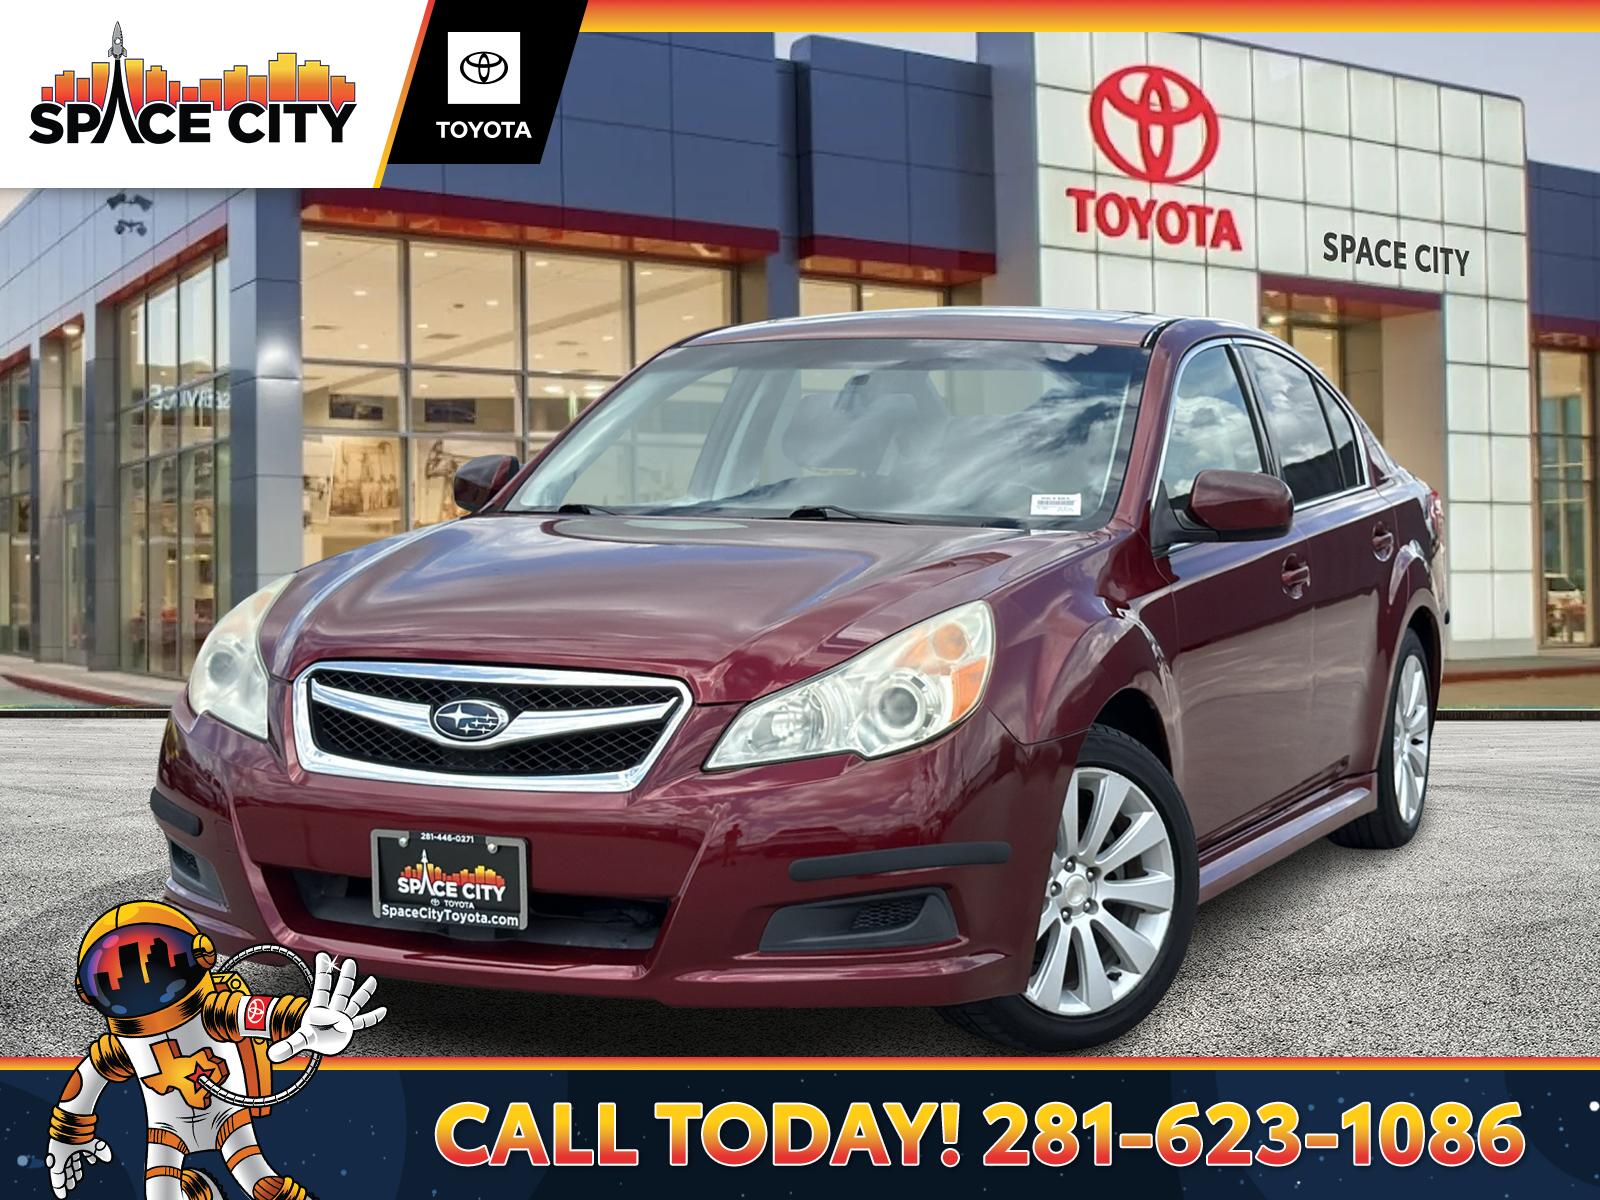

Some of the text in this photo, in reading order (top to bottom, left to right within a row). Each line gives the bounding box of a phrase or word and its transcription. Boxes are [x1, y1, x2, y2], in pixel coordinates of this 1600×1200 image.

[1066, 187, 1242, 251] TOYOTA
[1322, 232, 1471, 277] SPACE CITY
[397, 871, 506, 902] SPACE CITY
[381, 904, 519, 927] SpaceCityToyota.com
[444, 900, 475, 910] TOYOTA
